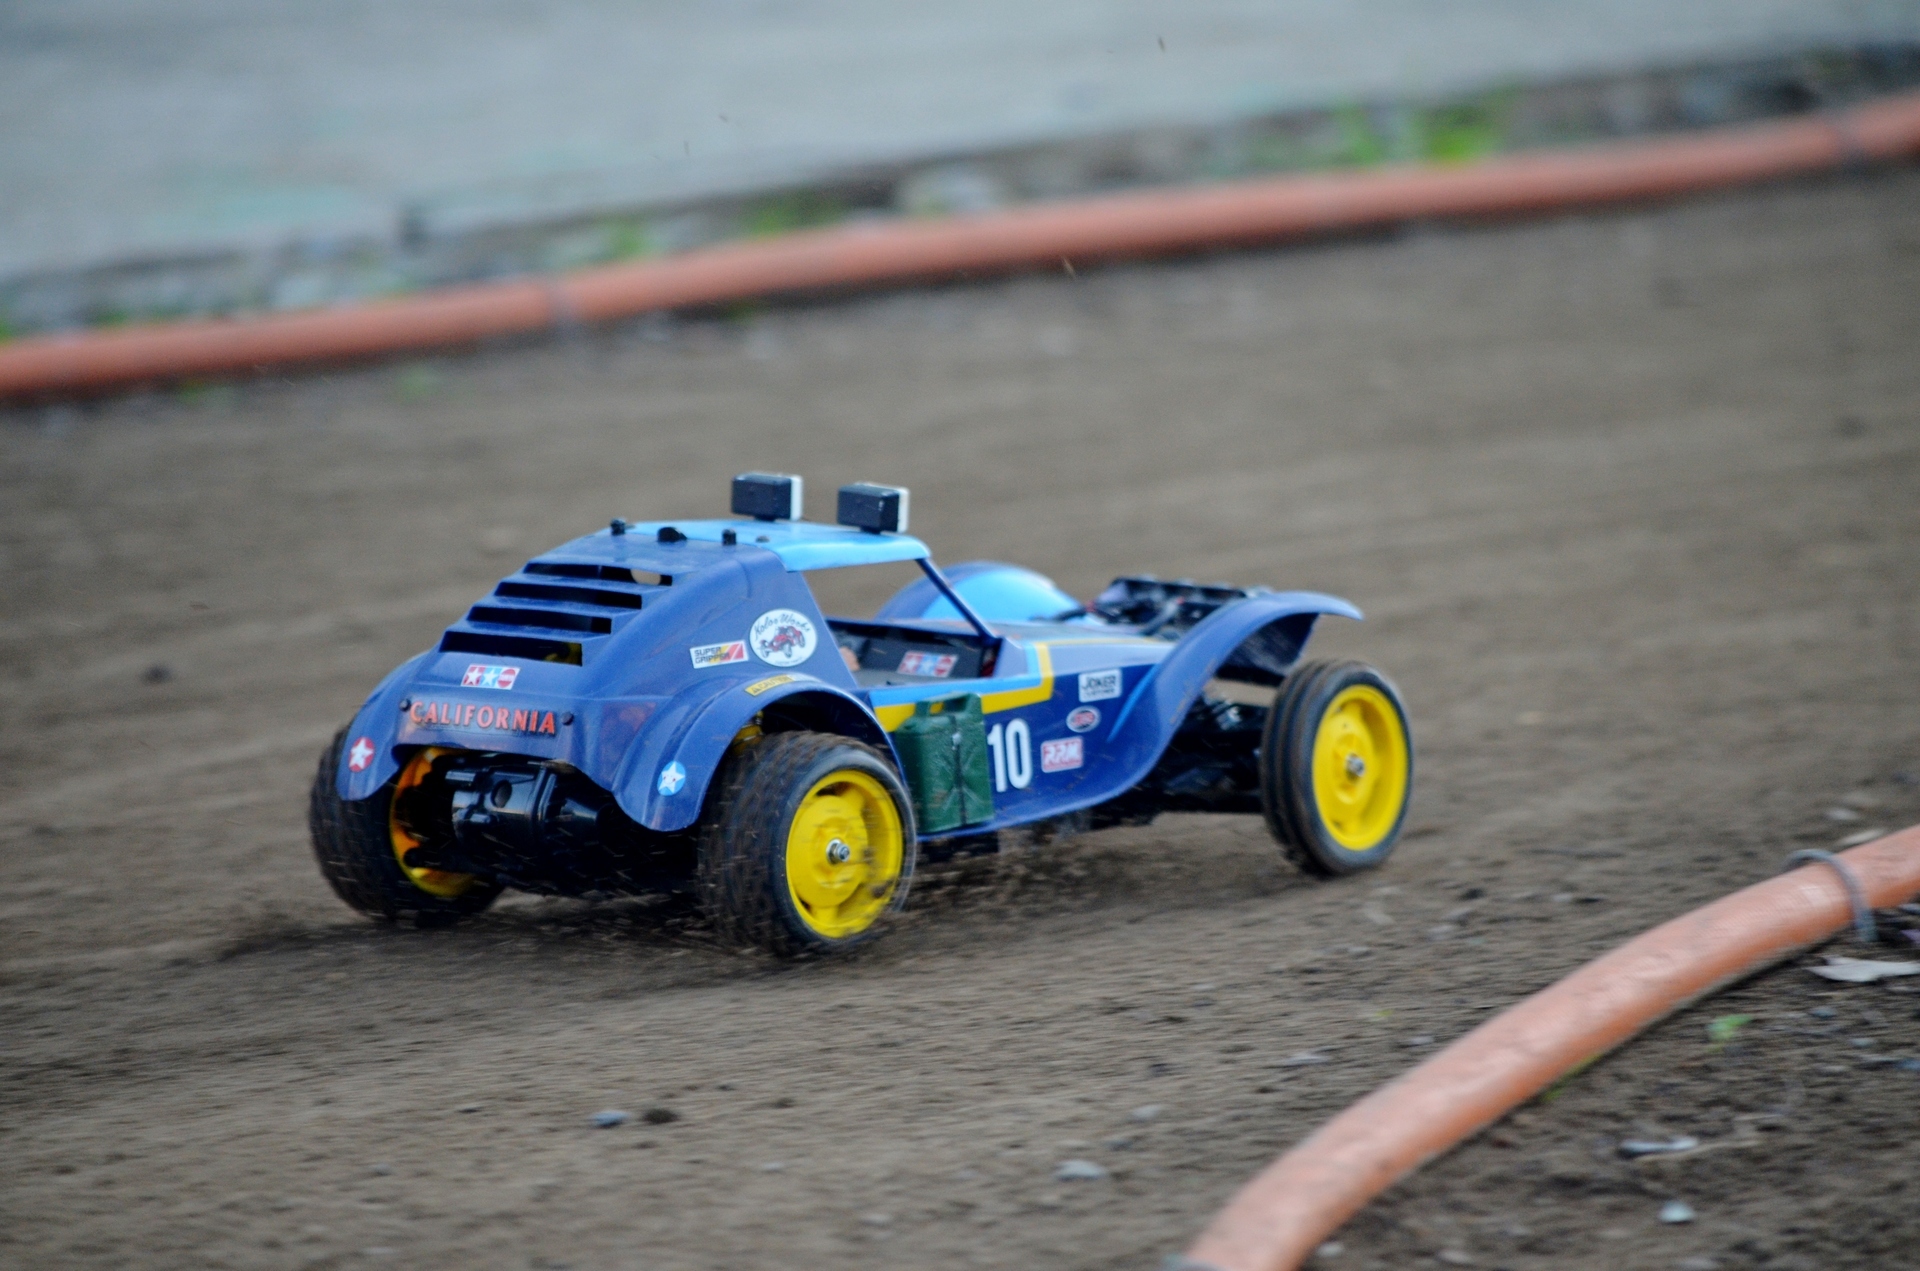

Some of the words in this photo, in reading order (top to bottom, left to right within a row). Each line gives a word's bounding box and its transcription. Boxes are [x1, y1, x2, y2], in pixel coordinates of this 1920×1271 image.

[694, 646, 722, 657] SUPER
[1082, 675, 1116, 690] JOKER
[410, 701, 555, 735] CALIFORNIA
[987, 718, 1032, 793] 10
